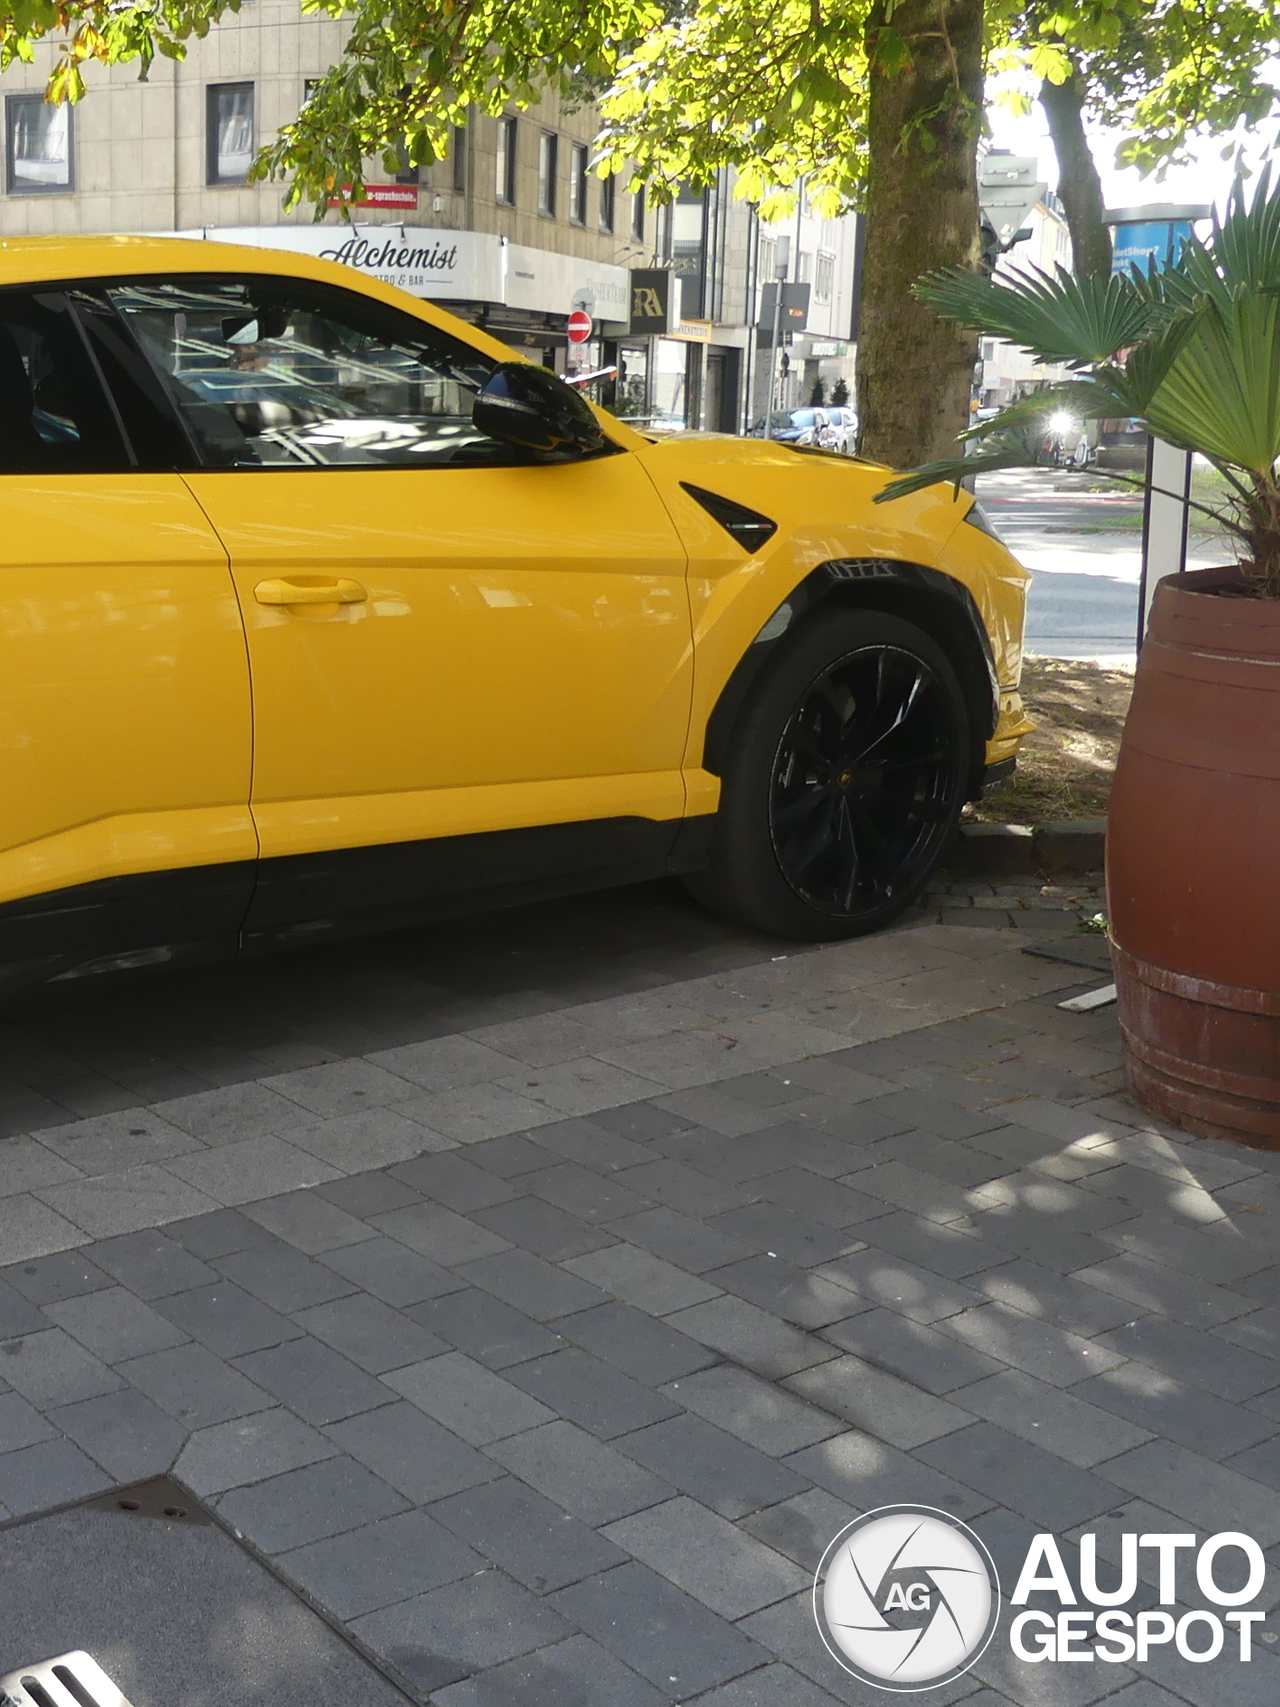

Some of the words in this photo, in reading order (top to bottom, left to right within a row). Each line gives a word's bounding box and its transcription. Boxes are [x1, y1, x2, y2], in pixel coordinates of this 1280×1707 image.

[319, 239, 458, 270] Alchemist
[397, 273, 406, 287] &
[408, 274, 424, 287] BAR
